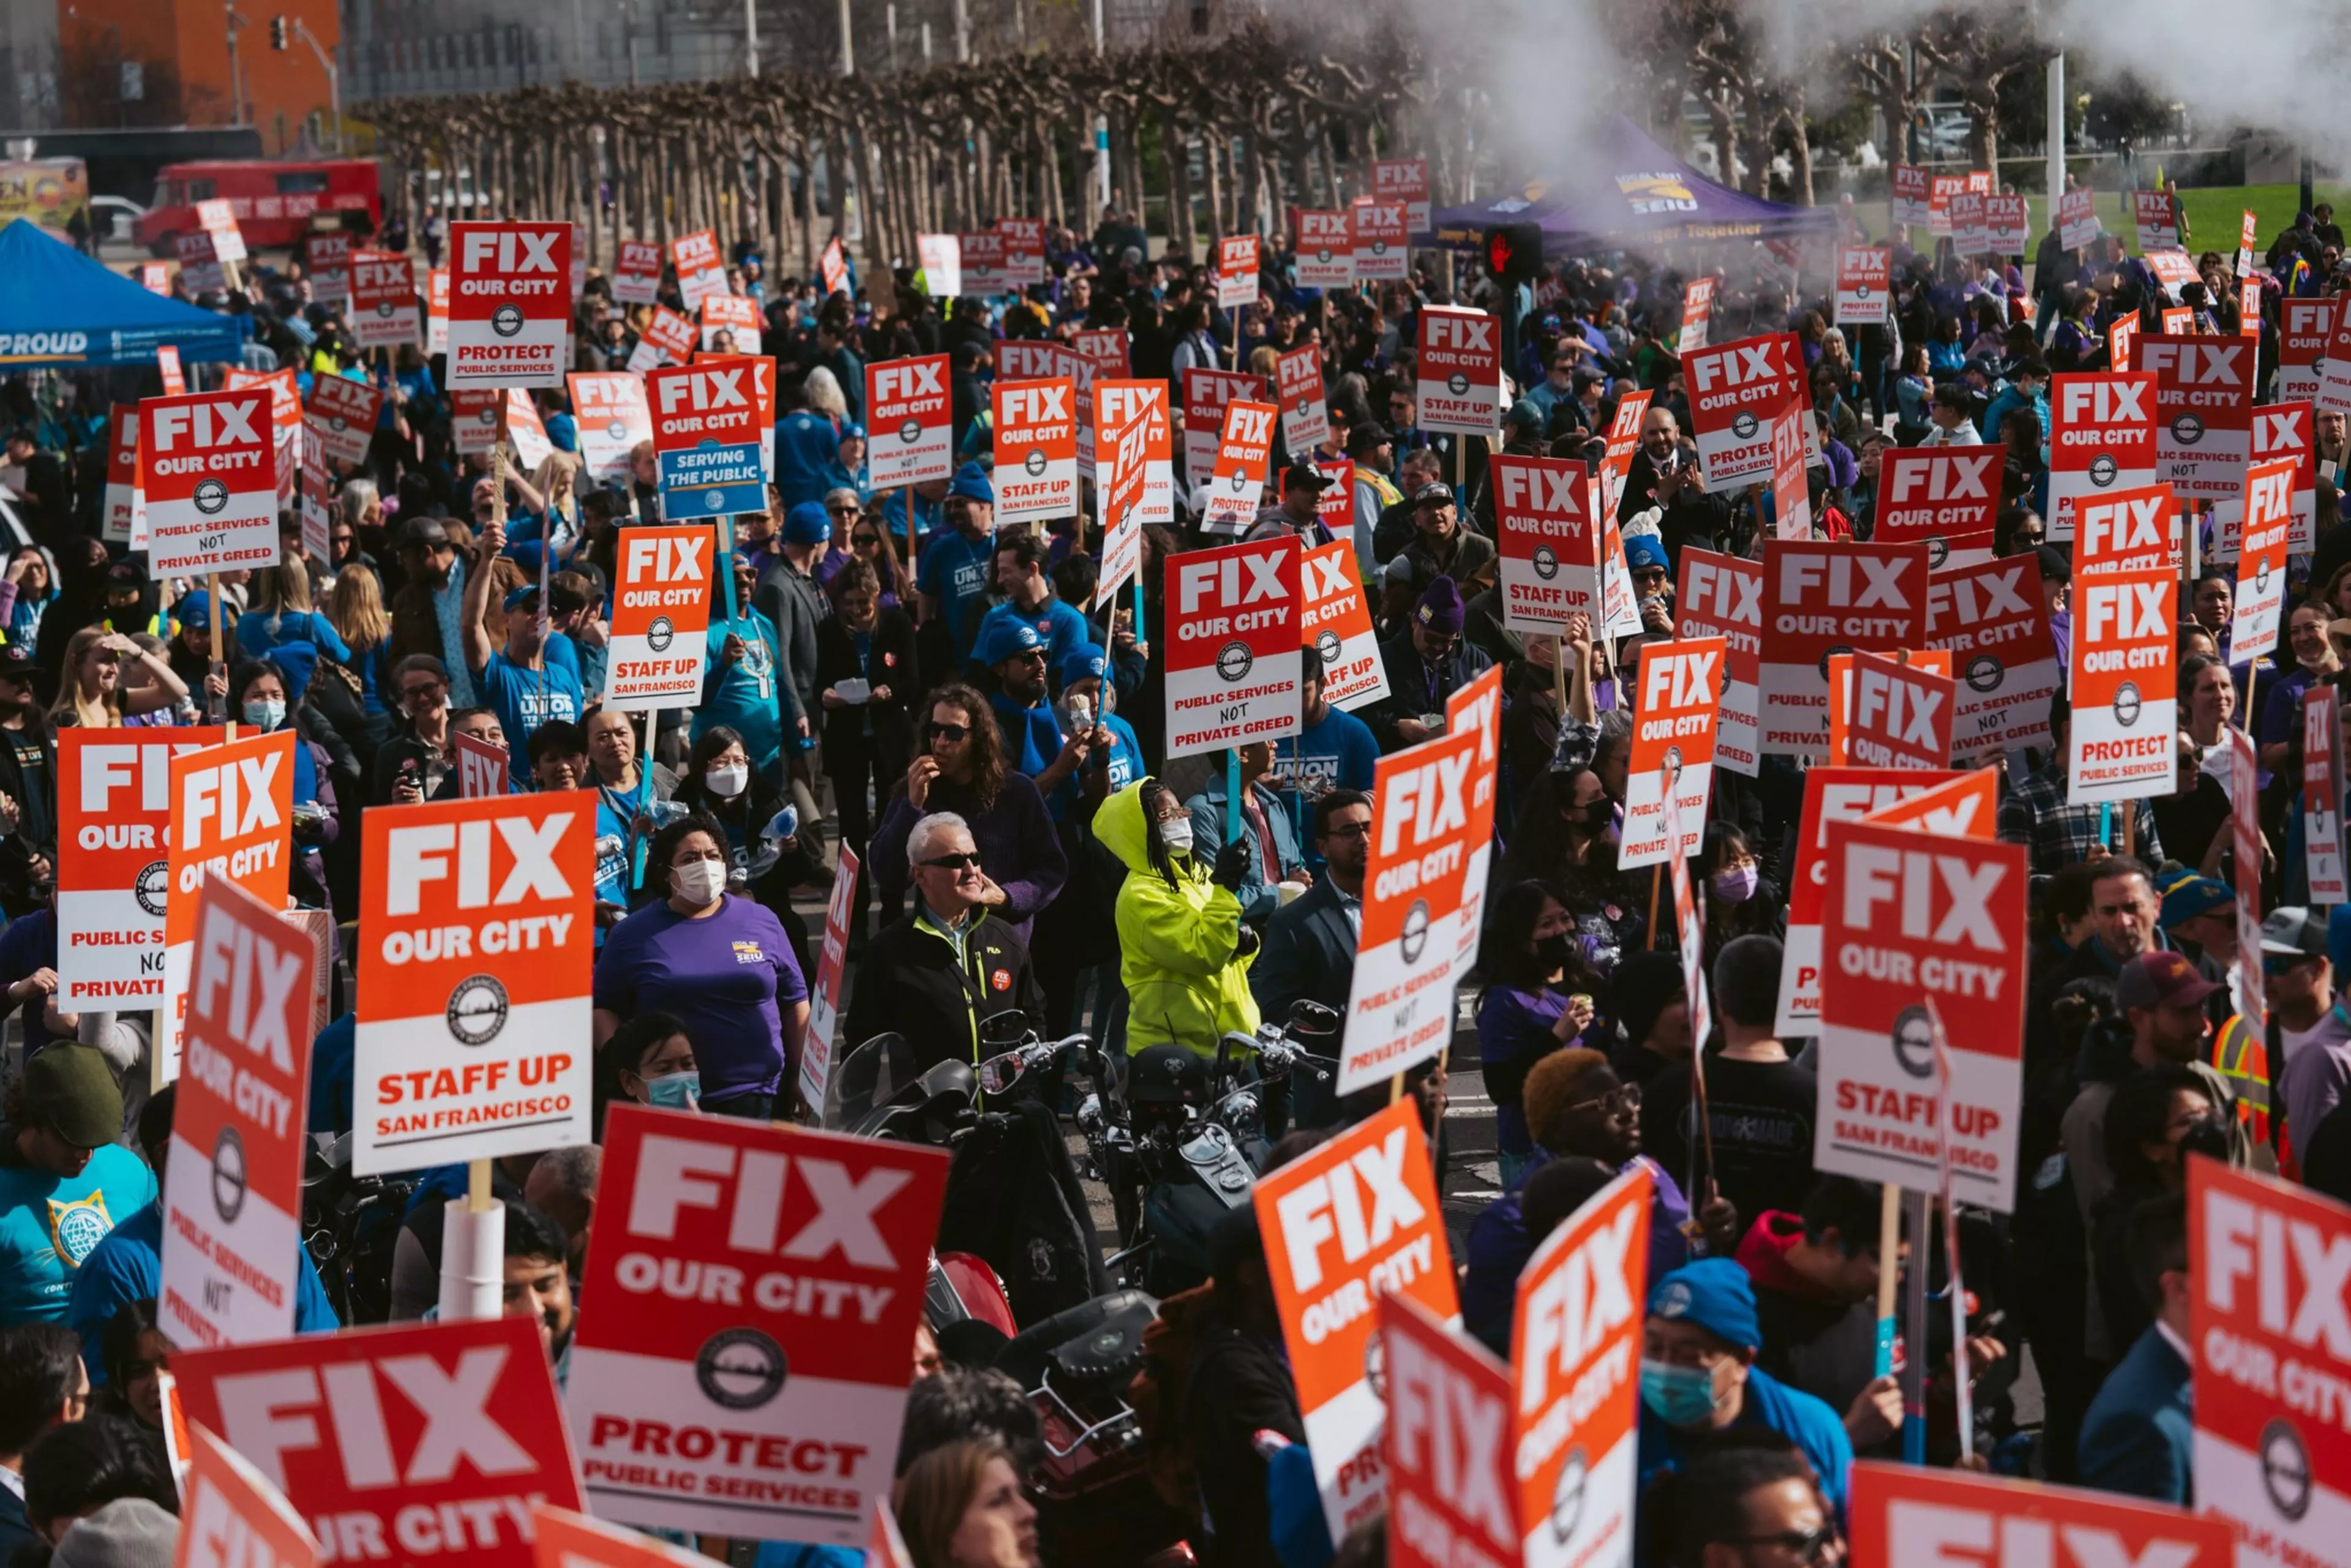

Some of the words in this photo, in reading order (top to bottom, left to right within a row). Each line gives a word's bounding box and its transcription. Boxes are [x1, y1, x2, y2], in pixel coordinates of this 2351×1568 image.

[1377, 165, 1421, 184] FIX
[1632, 199, 1698, 215] SEIU
[2137, 196, 2170, 210] FIX
[1303, 214, 1348, 235] FIX
[1357, 206, 1402, 227] FIX
[1686, 223, 1762, 239] Together
[463, 233, 560, 272] FIX
[675, 234, 713, 261] FIX
[1224, 240, 1256, 261] FIX
[1845, 251, 1884, 271] FIX
[354, 264, 407, 287] FIX
[460, 280, 505, 295] OUR
[509, 280, 558, 295] CITY
[0, 331, 88, 356] PROUD
[1427, 317, 1492, 351] FIX
[2289, 338, 2321, 348] OUR
[458, 345, 555, 360] PROTECT
[1426, 351, 1456, 365] OUR
[1459, 353, 1492, 367] CITY
[456, 365, 497, 374] PUBLIC
[1280, 350, 1317, 384] FIX
[1693, 342, 1778, 392] FIX
[576, 378, 638, 405] FIX
[658, 369, 749, 415] FIX
[874, 362, 944, 402] FIX
[876, 402, 907, 419] OUR
[909, 398, 945, 415] CITY
[1002, 385, 1068, 426] FIX
[1424, 398, 1469, 413] STAFF
[1472, 402, 1493, 413] UP
[1700, 389, 1738, 411] OUR
[1740, 383, 1779, 405] CITY
[2063, 381, 2148, 423] FIX
[2191, 392, 2241, 407] CITY
[662, 418, 703, 435] OUR
[707, 411, 749, 429] CITY
[1191, 406, 1223, 419] OUR
[1424, 411, 1440, 420] SAN
[1442, 413, 1493, 424] FRANCISCO
[154, 400, 261, 452] FIX
[1002, 428, 1034, 445] OUR
[1037, 426, 1068, 440] CITY
[1227, 407, 1273, 444] FIX
[2061, 431, 2102, 446] OUR
[2104, 429, 2147, 445] CITY
[874, 449, 904, 460] PUBLIC
[906, 443, 947, 455] SERVICES
[1775, 409, 1801, 470] FIX
[155, 456, 204, 475] OUR
[209, 451, 261, 470] CITY
[677, 451, 746, 468] SERVING
[1223, 446, 1242, 458] OUR
[1244, 449, 1265, 462] CITY
[2180, 452, 2241, 462] SERVICES
[669, 471, 699, 486] THE
[702, 466, 758, 484] PUBLIC
[874, 469, 913, 482] PRIVATE
[914, 465, 946, 477] GREED
[1891, 455, 1995, 503] FIX
[2172, 463, 2198, 476] NOT
[1002, 482, 1046, 498] STAFF
[1049, 480, 1070, 493] UP
[1500, 465, 1581, 513] FIX
[2192, 481, 2240, 491] GREED
[1002, 501, 1022, 511] SAN
[1024, 497, 1070, 508] FRANCISCO
[1211, 497, 1254, 511] PROTECT
[2248, 470, 2292, 527] FIX
[156, 523, 202, 538] PUBLIC
[205, 517, 269, 532] SERVICES
[1505, 516, 1540, 532] OUR
[1543, 519, 1582, 538] CITY
[1887, 509, 1933, 527] OUR
[1937, 506, 1987, 523] CITY
[2083, 496, 2164, 557] FIX
[200, 534, 227, 552] NOT
[2245, 533, 2265, 553] OUR
[2267, 524, 2287, 548] CITY
[157, 552, 220, 569] PRIVATE
[223, 548, 272, 562] GREED
[627, 537, 706, 583] FIX
[1180, 549, 1289, 614] FIX
[1779, 553, 1913, 609] FIX
[623, 590, 661, 607] OUR
[664, 588, 703, 605] CITY
[1510, 584, 1561, 603] STAFF
[1565, 590, 1589, 606] UP
[1320, 595, 1357, 620] CITY
[1512, 604, 1531, 614] SAN
[2085, 581, 2170, 643] FIX
[1179, 617, 1229, 641] OUR
[1235, 607, 1289, 632] CITY
[1776, 615, 1836, 636] OUR
[1842, 618, 1911, 638] CITY
[1978, 625, 2034, 645] CITY
[617, 661, 670, 678] STAFF
[675, 659, 697, 673] UP
[1352, 657, 1374, 675] UP
[2084, 650, 2124, 673] OUR
[2127, 645, 2169, 667] CITY
[614, 683, 636, 694] SAN
[638, 680, 696, 691] FRANCISCO
[1322, 676, 1378, 703] FRANCISCO
[1644, 651, 1717, 711] FIX
[1175, 694, 1224, 711] PUBLIC
[1227, 681, 1294, 700] SERVICES
[1983, 686, 2053, 710] SERVICES
[1220, 702, 1248, 724] NOT
[1859, 665, 1944, 753] FIX
[1978, 710, 2008, 732] NOT
[1175, 725, 1240, 747] PRIVATE
[1243, 716, 1294, 734] GREED
[1641, 719, 1674, 741] OUR
[1675, 713, 1712, 734] CITY
[1717, 745, 1753, 763] GREED
[2082, 735, 2167, 762] PROTECT
[2080, 766, 2118, 781] PUBLIC
[2123, 761, 2169, 776] SERVICES
[183, 751, 283, 852] FIX
[1379, 748, 1474, 858] FIX
[1630, 802, 1662, 817] PUBLIC
[78, 825, 156, 851] OUR
[1626, 839, 1667, 857] PRIVATE
[231, 840, 280, 880] CITY
[387, 812, 576, 917] FIX
[1374, 860, 1419, 903] OUR
[1422, 839, 1464, 883] CITY
[1842, 842, 2009, 953] FIX
[71, 930, 146, 947] PUBLIC
[381, 925, 473, 966] OUR
[479, 913, 574, 955] CITY
[1839, 943, 1915, 986] OUR
[1919, 956, 2007, 1002] CITY
[195, 903, 304, 1077] FIX
[378, 1060, 509, 1105] STAFF
[519, 1053, 572, 1086] UP
[377, 1115, 427, 1136] SAN
[434, 1095, 571, 1129] FRANCISCO
[1952, 1103, 2000, 1139] UP
[627, 1133, 915, 1272] FIX
[1276, 1125, 1427, 1295] FIX
[615, 1252, 746, 1307] OUR
[754, 1272, 895, 1325] CITY
[1301, 1278, 1371, 1345] OUR
[1519, 1201, 1640, 1416] FIX
[590, 1413, 869, 1479] PROTECT
[582, 1458, 699, 1494] PUBLIC
[704, 1474, 863, 1510] SERVICES
